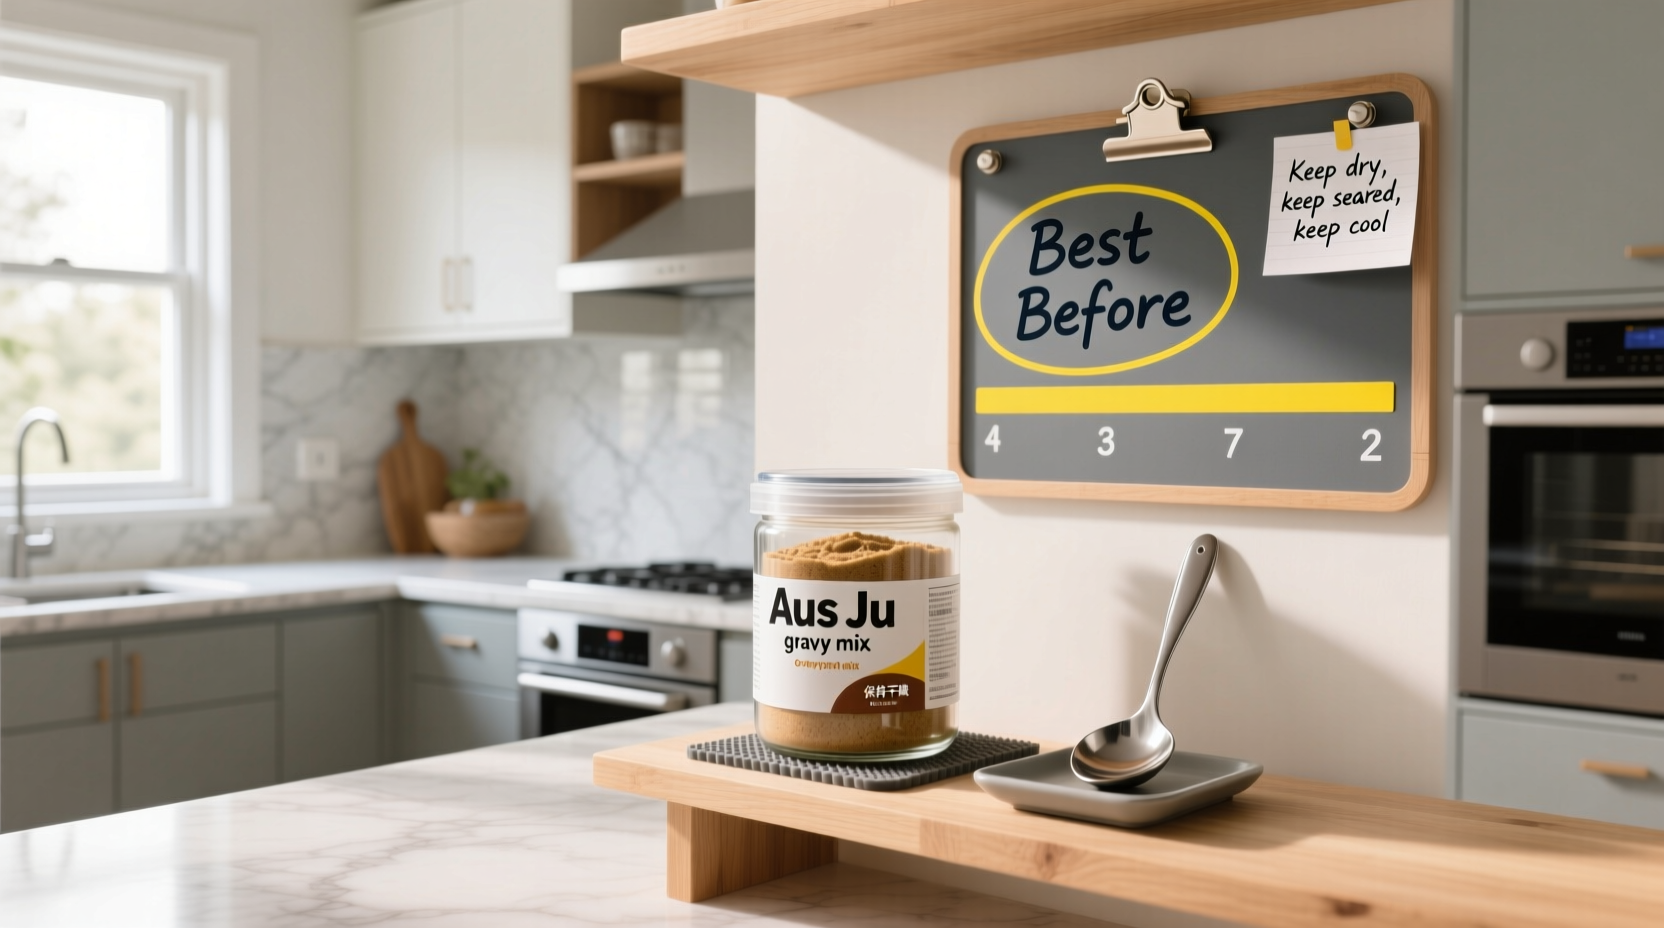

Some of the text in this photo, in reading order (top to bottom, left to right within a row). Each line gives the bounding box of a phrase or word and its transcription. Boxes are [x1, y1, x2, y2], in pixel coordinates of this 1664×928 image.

[1289, 151, 1387, 190] Keep dry,
[1281, 177, 1401, 219] keep seared,
[1029, 210, 1154, 276] Best
[1293, 208, 1390, 248] keep cool
[1015, 278, 1193, 350] Before
[984, 424, 1382, 462] 4 3 7 2
[768, 586, 896, 629] Aus Ju
[784, 633, 872, 656] gravy mix
